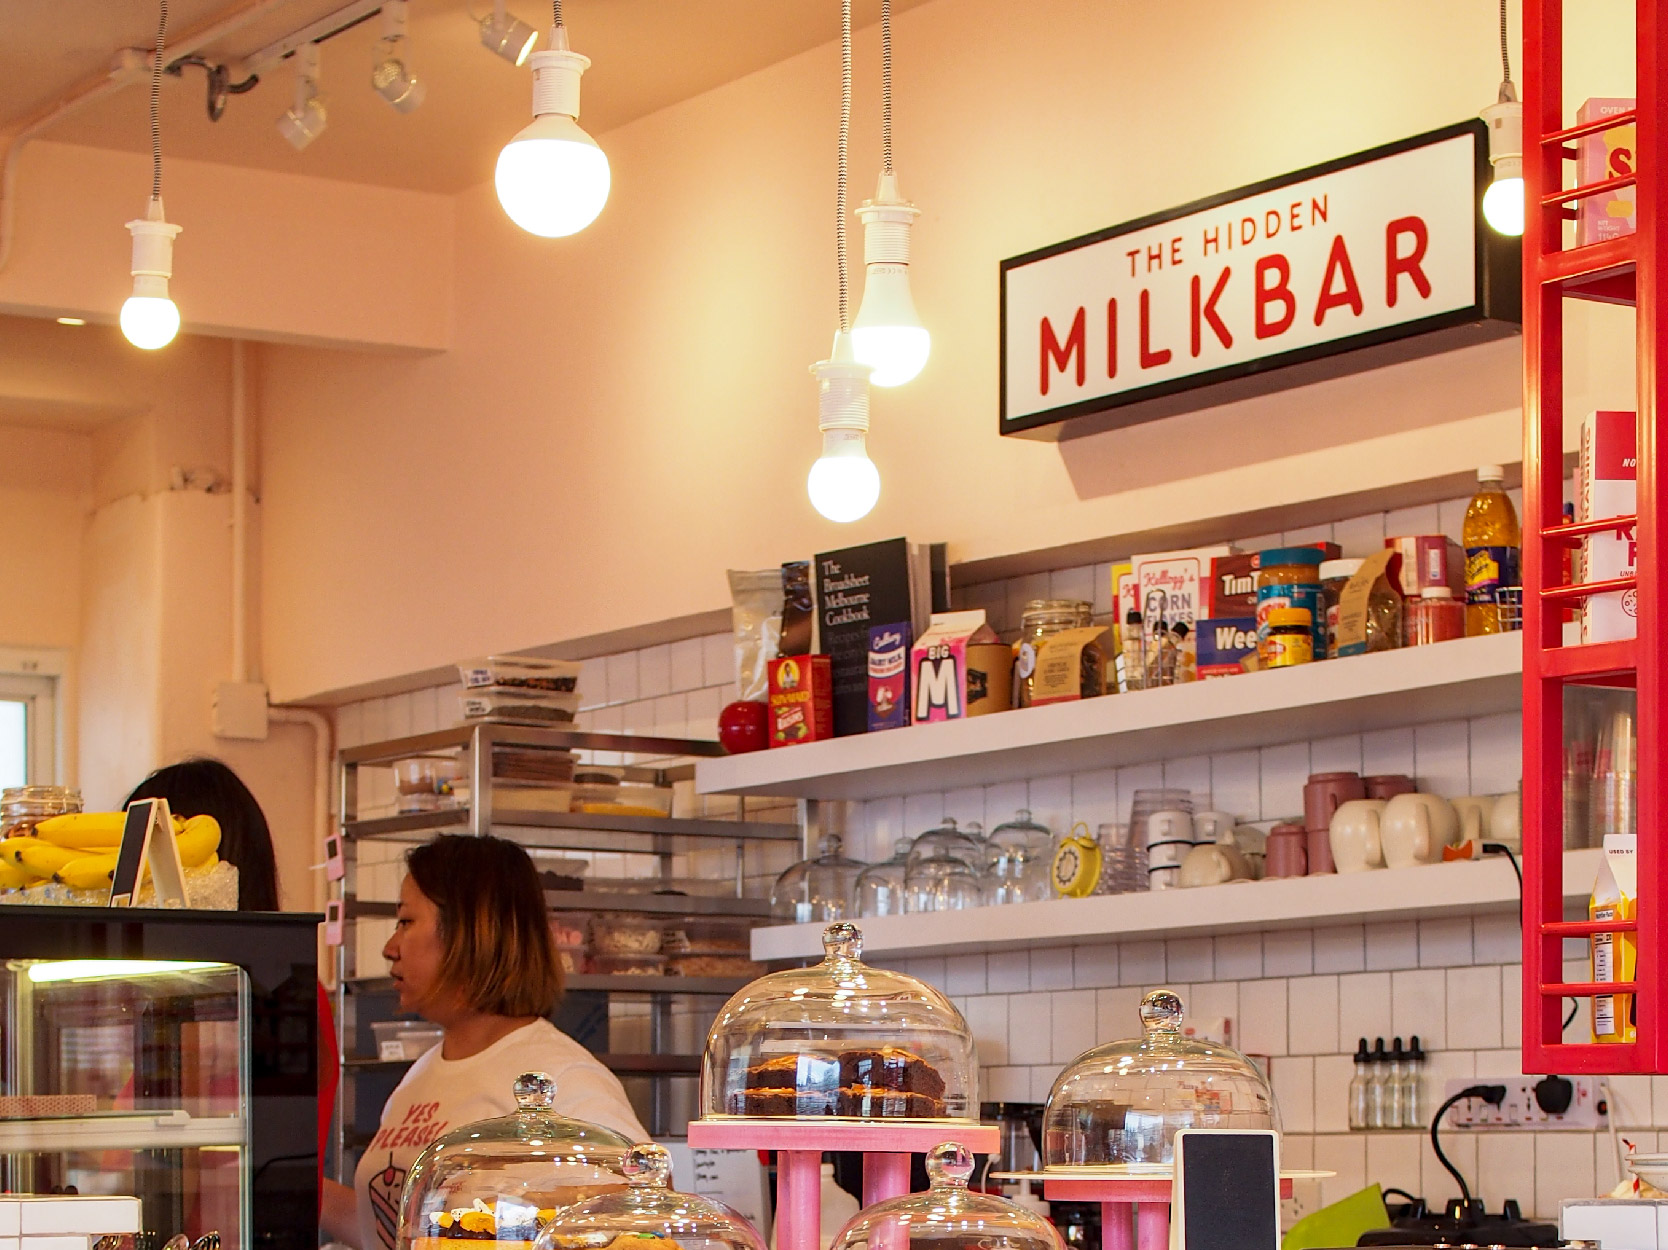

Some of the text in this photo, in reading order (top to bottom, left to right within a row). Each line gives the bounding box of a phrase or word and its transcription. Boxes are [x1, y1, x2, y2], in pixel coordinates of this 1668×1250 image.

[1126, 194, 1330, 278] THE HIDDEN
[1039, 215, 1432, 396] MILKBAR
[822, 560, 841, 575] The
[1144, 568, 1195, 591] Kellogg's
[1147, 593, 1192, 612] CORN
[825, 606, 870, 626] Cookbook
[928, 645, 950, 660] BIG
[916, 658, 960, 719] M
[402, 1102, 440, 1125] YES
[371, 1121, 448, 1152] PLEASE!
